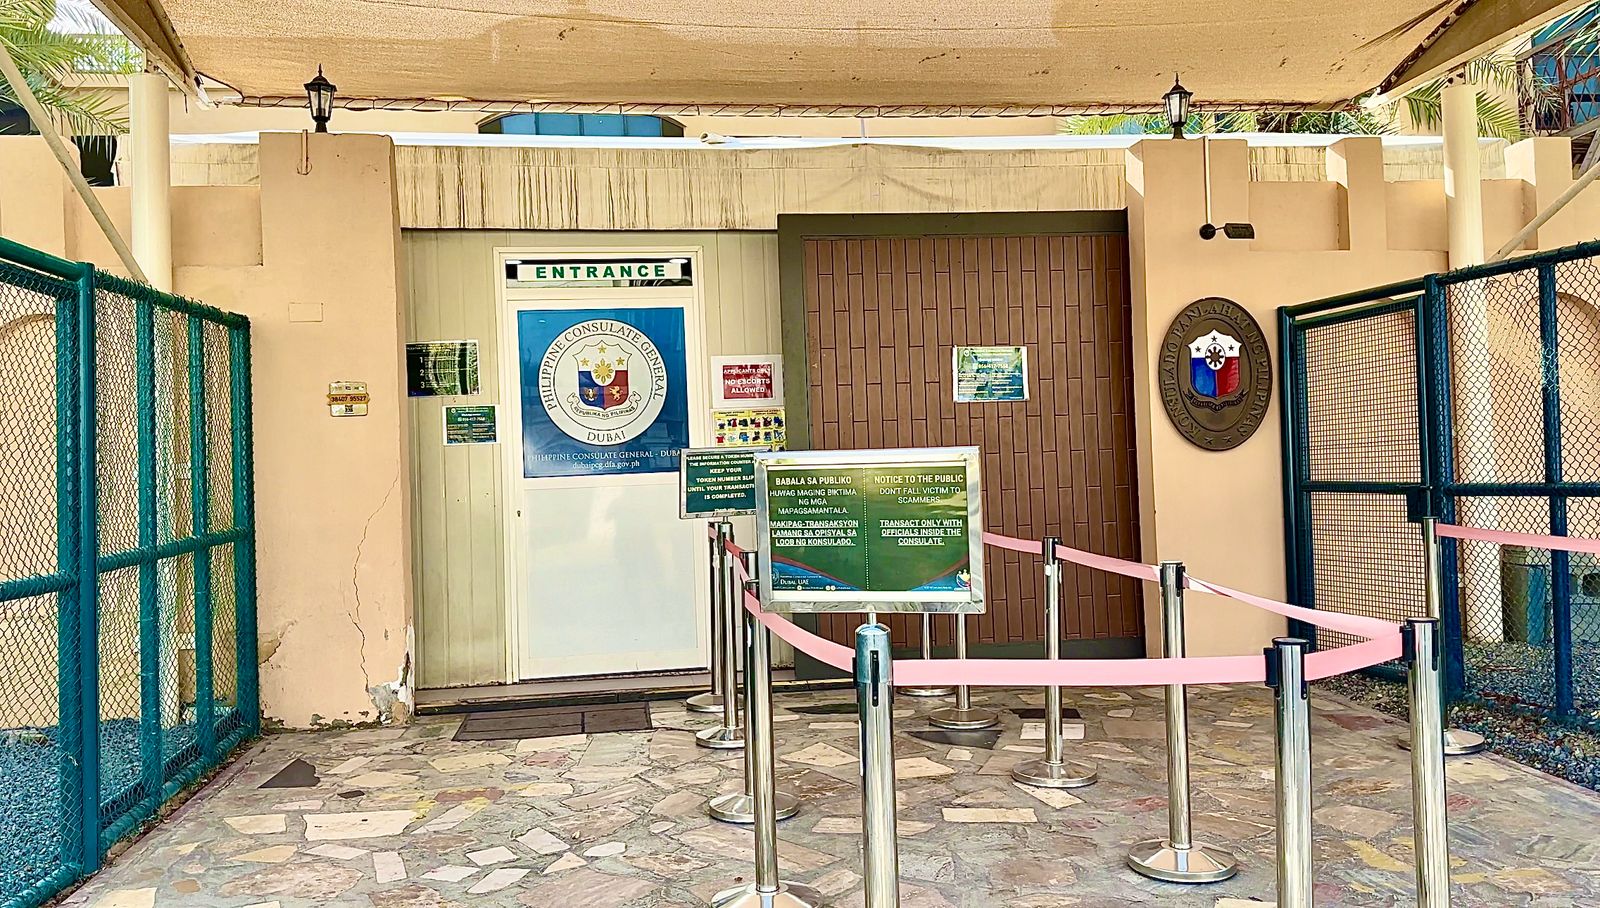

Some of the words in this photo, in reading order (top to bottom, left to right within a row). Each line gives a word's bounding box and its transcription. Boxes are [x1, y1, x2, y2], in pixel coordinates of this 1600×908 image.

[536, 264, 665, 279] ENTRANCE
[1172, 304, 1250, 339] PANLAHAT
[1246, 331, 1264, 354] NG
[541, 341, 566, 411] PHILIPPINE
[564, 321, 642, 343] CONSULATE
[640, 341, 665, 401] GENERAL
[1163, 342, 1200, 438] KONSULADO
[1237, 359, 1269, 437] PILIPINAS
[587, 430, 626, 442] DUBAI
[573, 451, 617, 460] CONSULATE
[619, 450, 653, 459] GENERAL
[660, 449, 680, 458] DUBA
[775, 477, 806, 485] BABALA
[807, 477, 818, 485] SA
[819, 476, 852, 484] PUBLIKO
[874, 475, 903, 484] NOTICE
[904, 475, 916, 483] TO
[917, 475, 934, 483] THE
[935, 474, 964, 482] PUBLIC
[769, 520, 859, 528] MAKIPAG-TRANSAKSYON
[921, 519, 941, 527] ONLY
[942, 519, 962, 527] WITH
[815, 529, 846, 537] OPISYAL
[847, 529, 857, 537] SA
[920, 528, 945, 536] INSIDE
[946, 528, 962, 536] THE
[775, 538, 794, 546] LOOB
[807, 538, 855, 546] KONSULADO.
[898, 538, 945, 546] CONSULATE.
